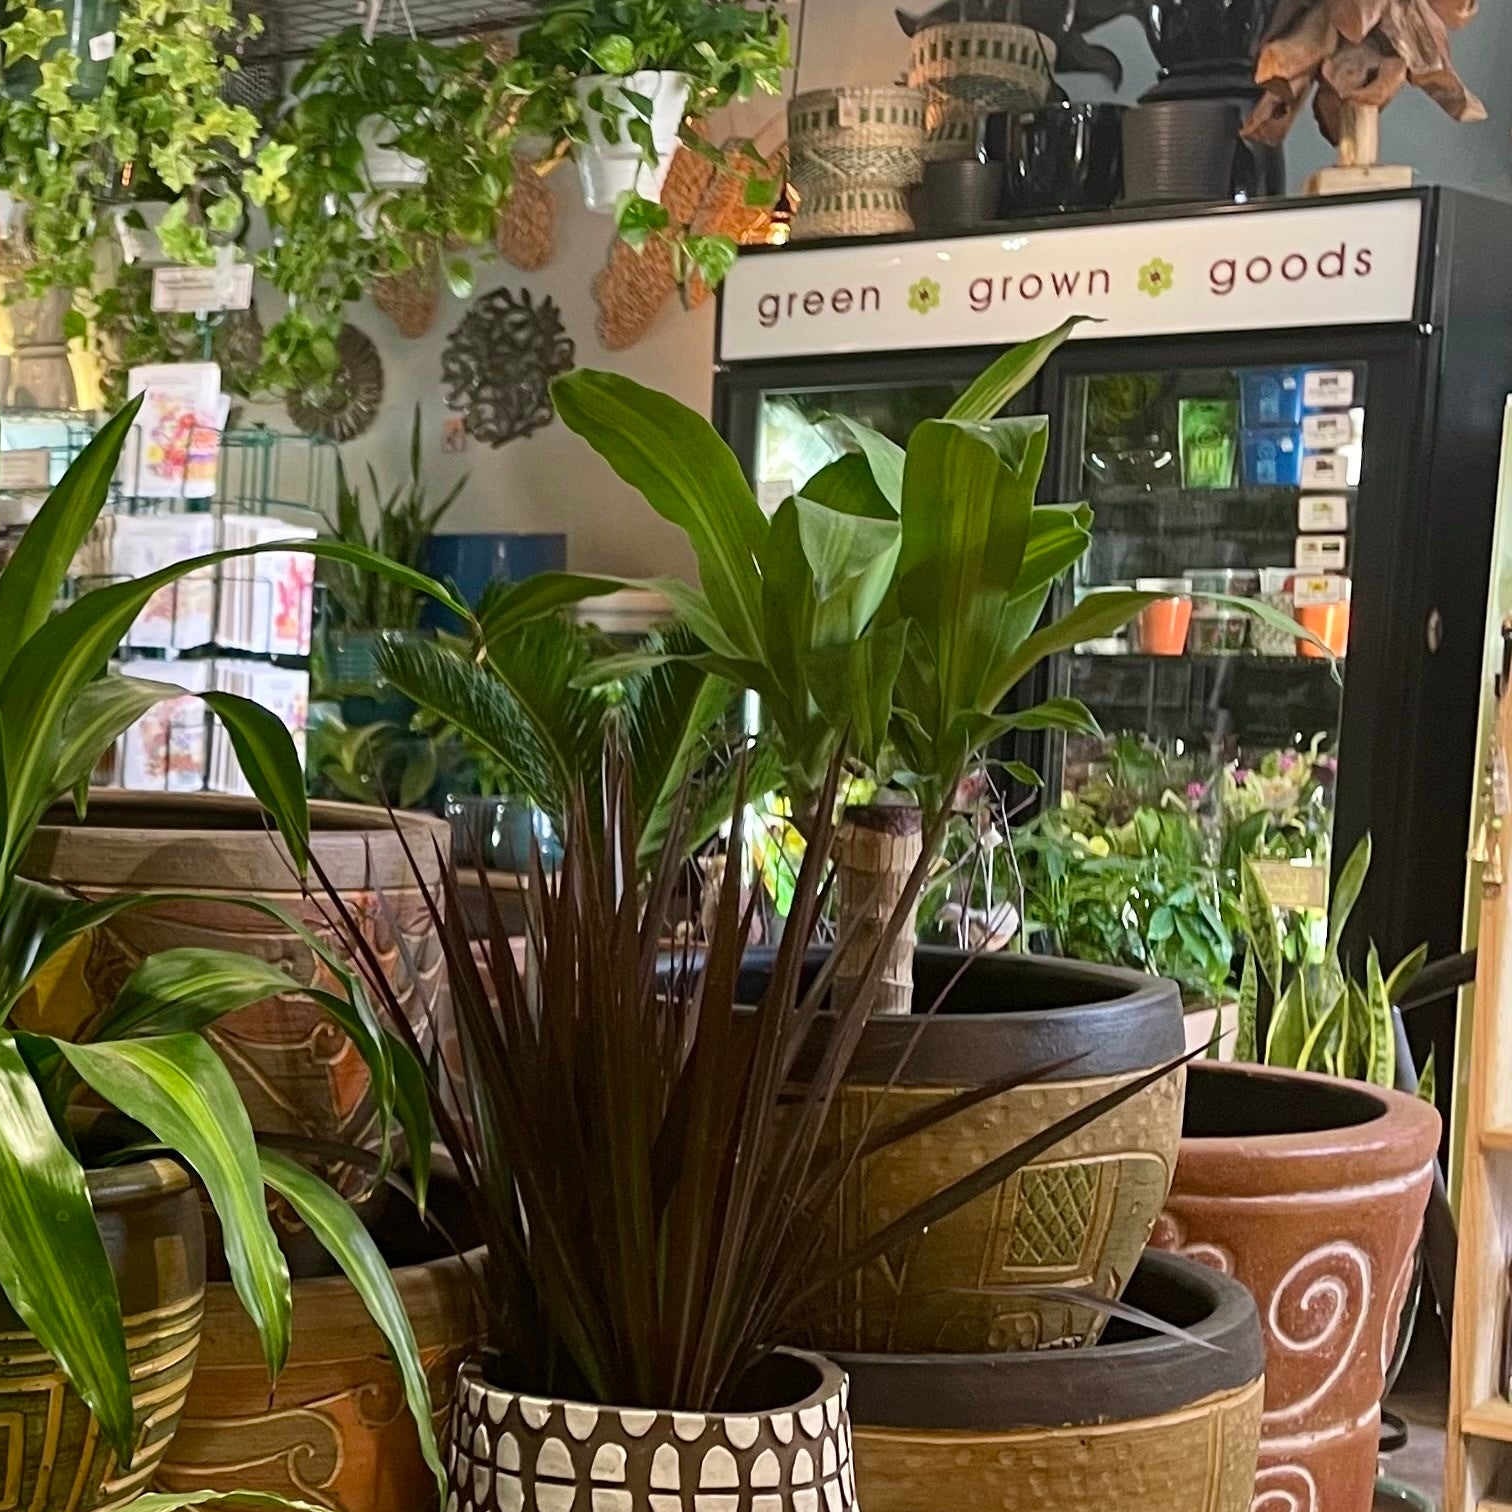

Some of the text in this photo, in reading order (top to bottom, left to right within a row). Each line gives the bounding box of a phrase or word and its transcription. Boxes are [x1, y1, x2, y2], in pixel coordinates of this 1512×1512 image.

[757, 242, 1372, 328] green grown goods
